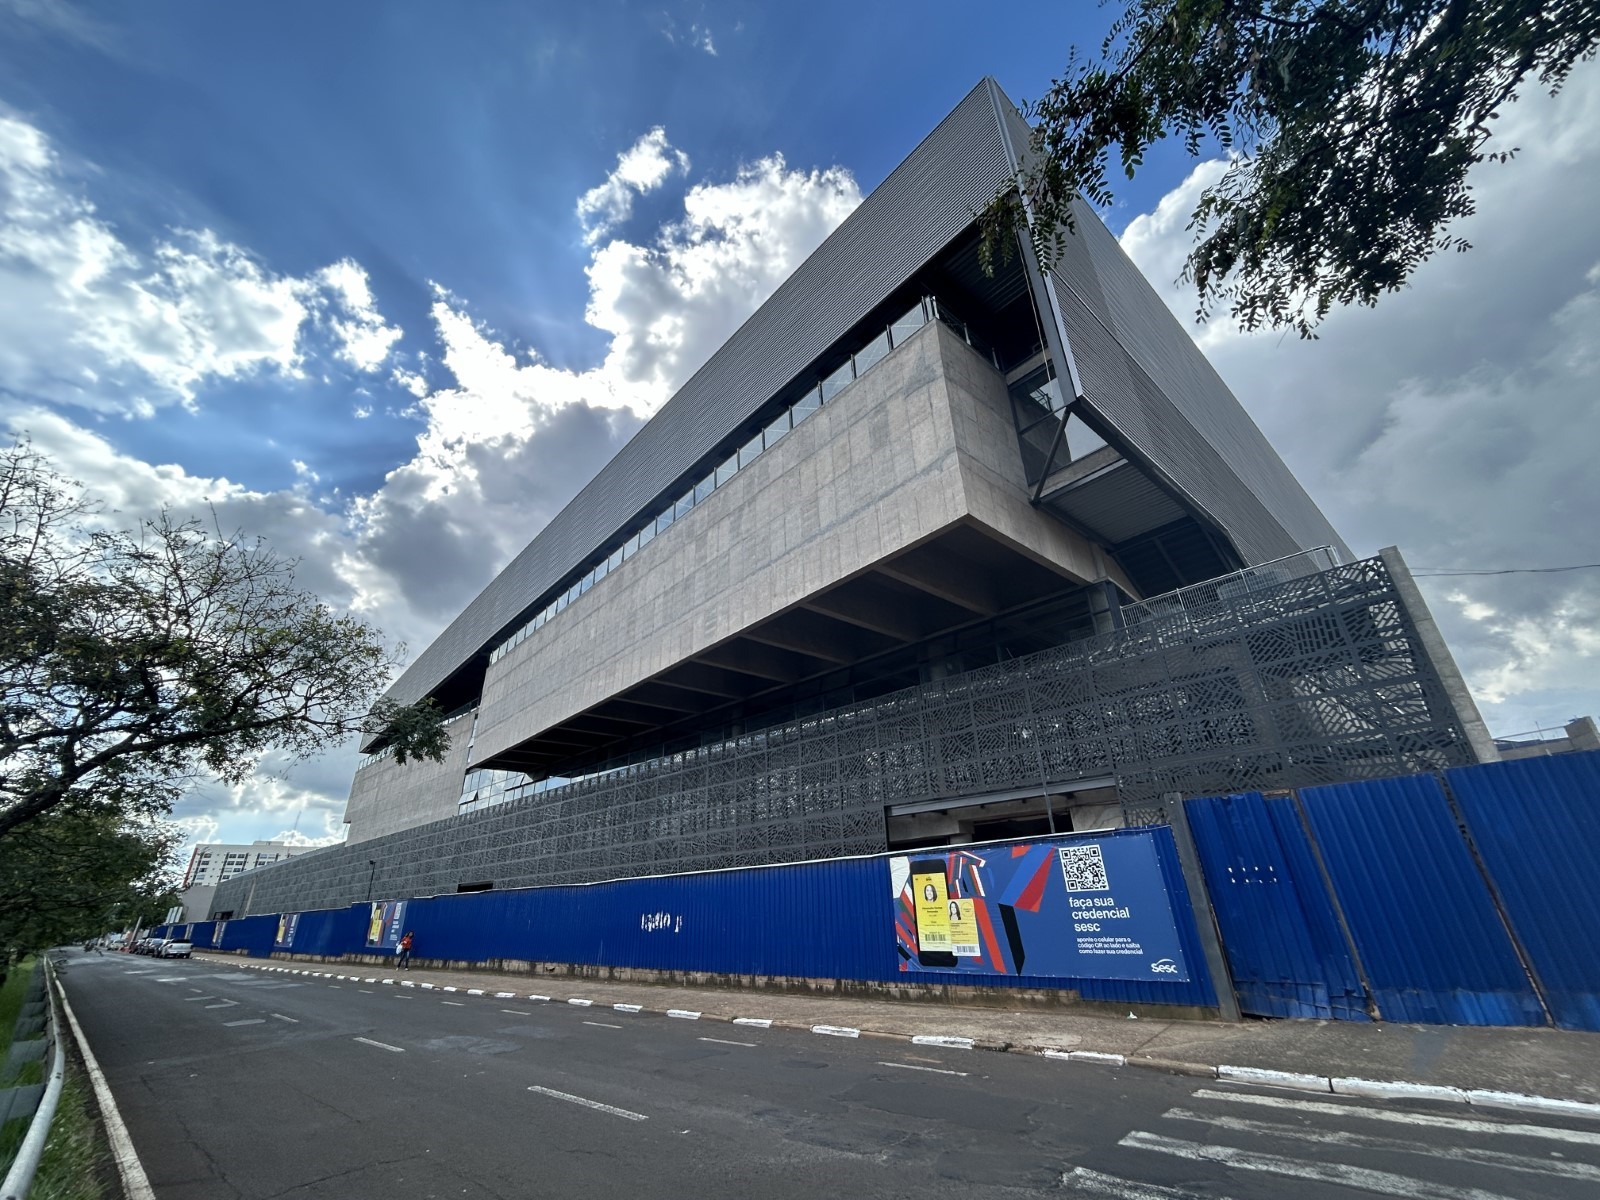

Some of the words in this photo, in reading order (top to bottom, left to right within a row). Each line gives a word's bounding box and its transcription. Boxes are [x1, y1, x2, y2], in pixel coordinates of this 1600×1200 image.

[1069, 897, 1093, 909] faça
[1094, 897, 1114, 906] sua
[1072, 907, 1130, 919] credencial
[1074, 923, 1100, 931] sesc
